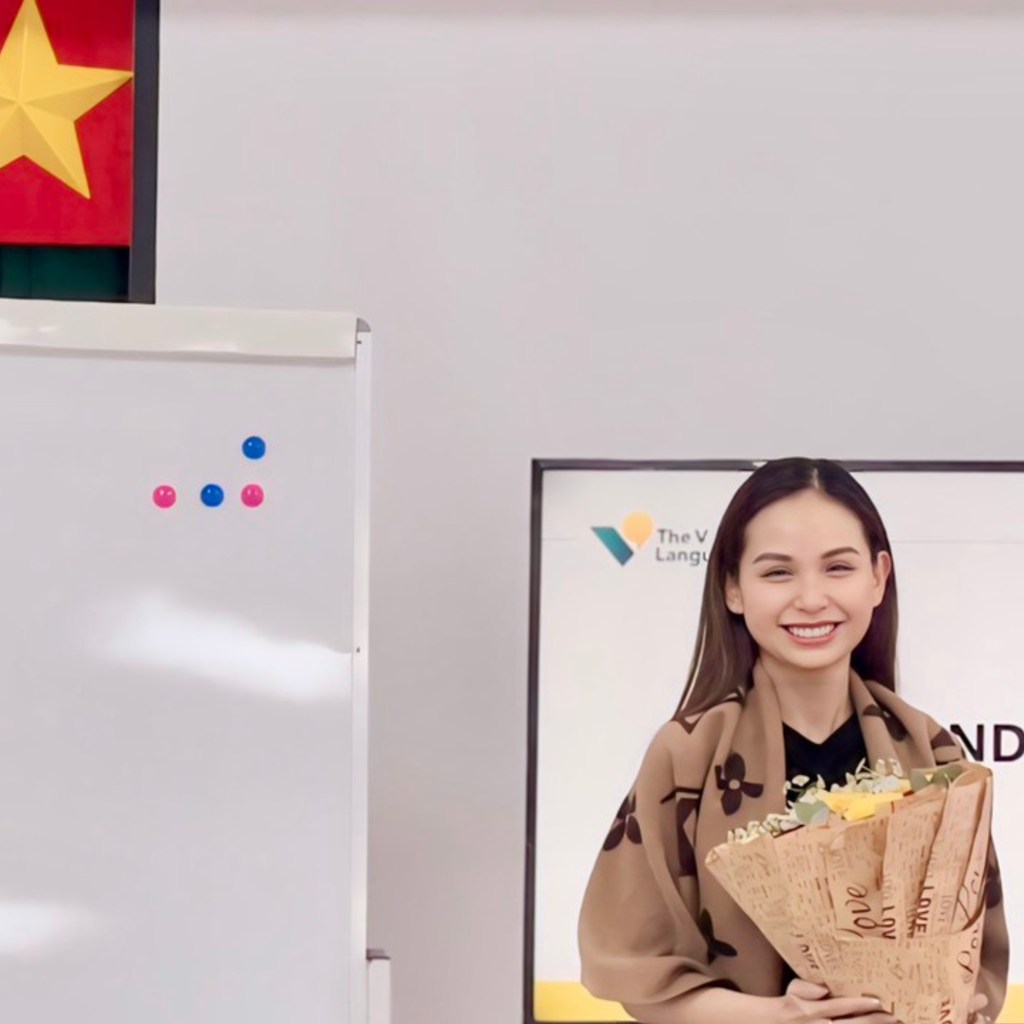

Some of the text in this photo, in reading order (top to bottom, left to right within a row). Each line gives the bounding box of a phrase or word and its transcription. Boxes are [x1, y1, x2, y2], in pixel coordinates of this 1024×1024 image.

[657, 529, 709, 544] The V
[656, 547, 709, 566] Langu
